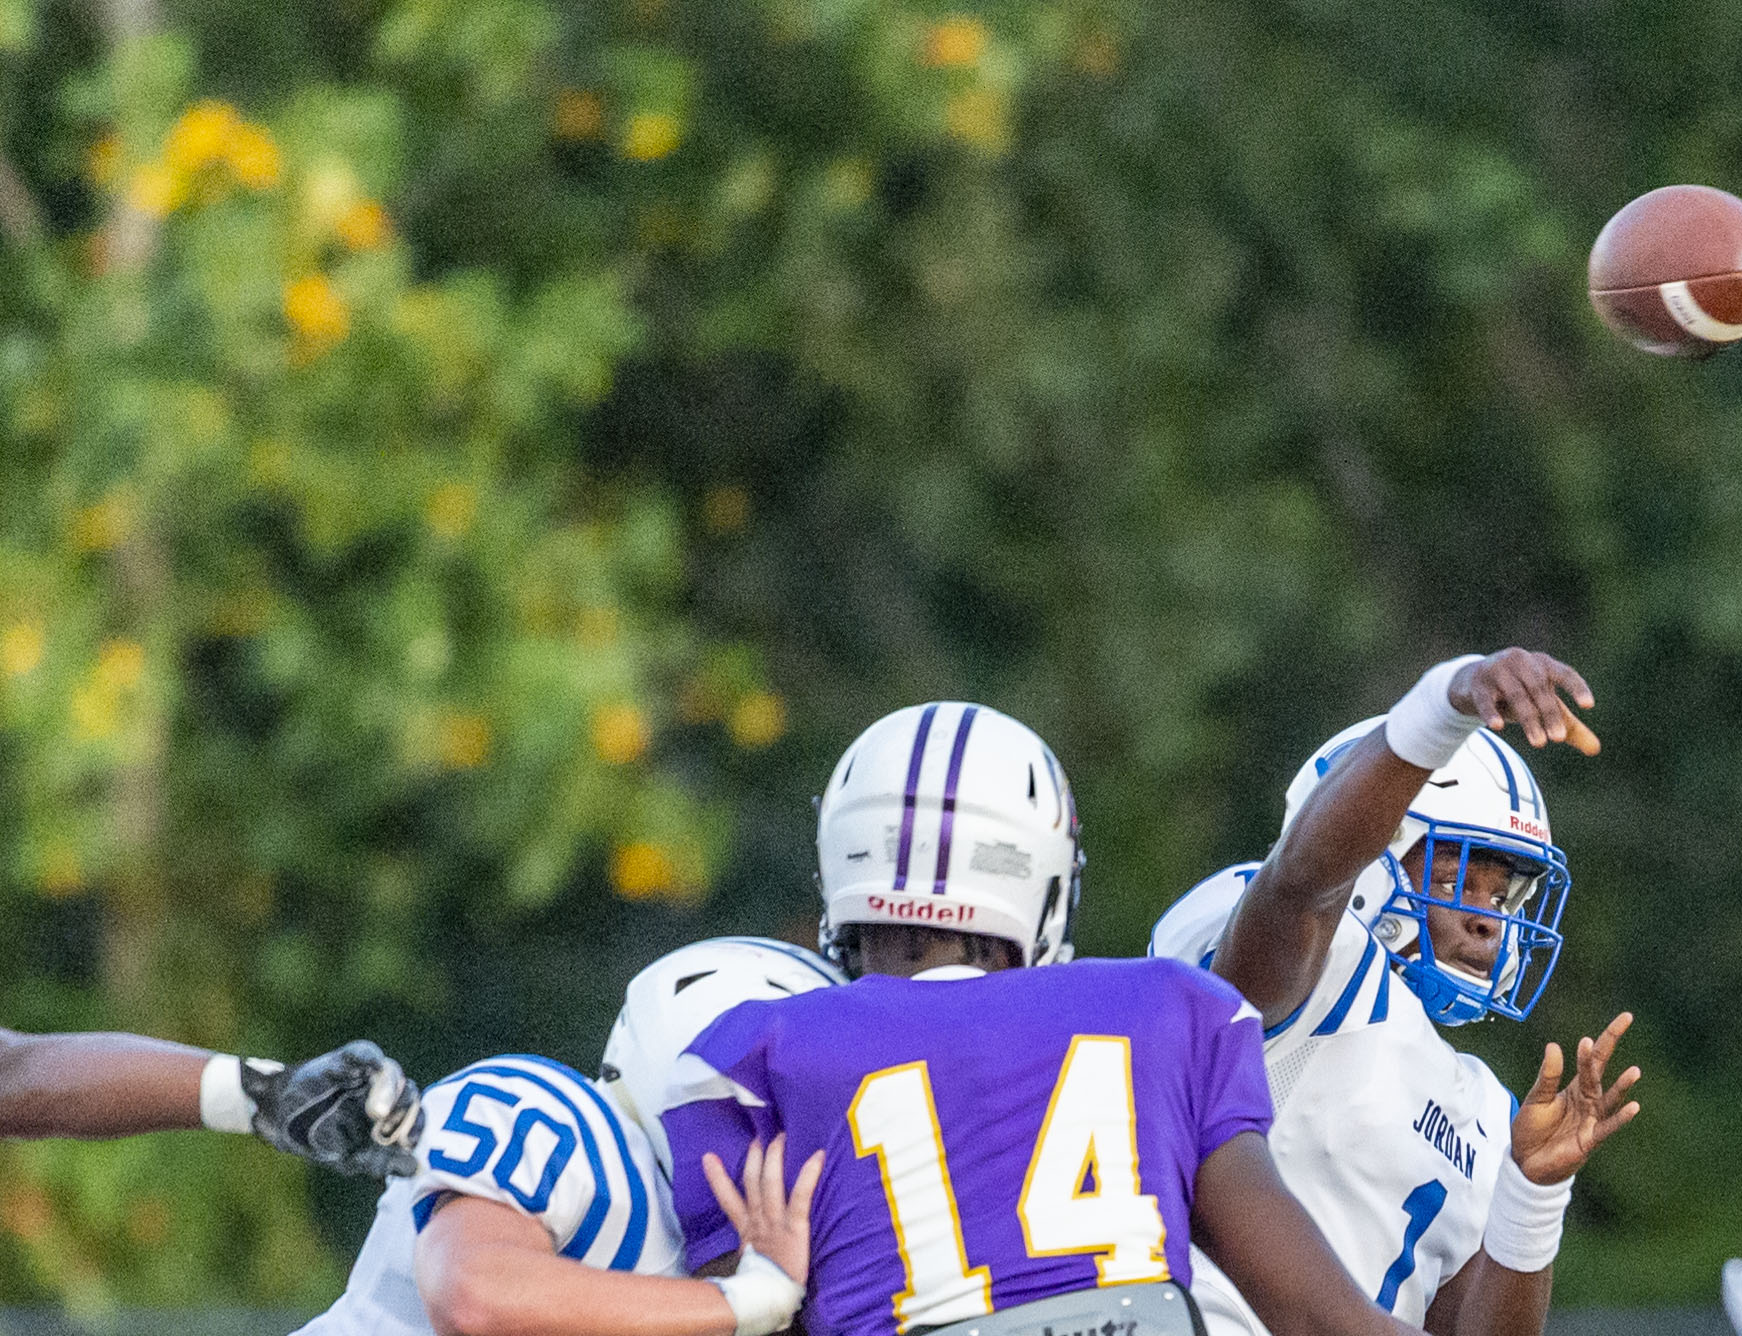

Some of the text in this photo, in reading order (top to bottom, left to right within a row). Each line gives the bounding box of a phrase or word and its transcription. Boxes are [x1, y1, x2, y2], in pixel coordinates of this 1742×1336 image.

[428, 1081, 577, 1214] 50
[847, 1034, 1170, 1334] 14
[1413, 1099, 1476, 1182] JORDAN
[1375, 1178, 1448, 1315] 1
